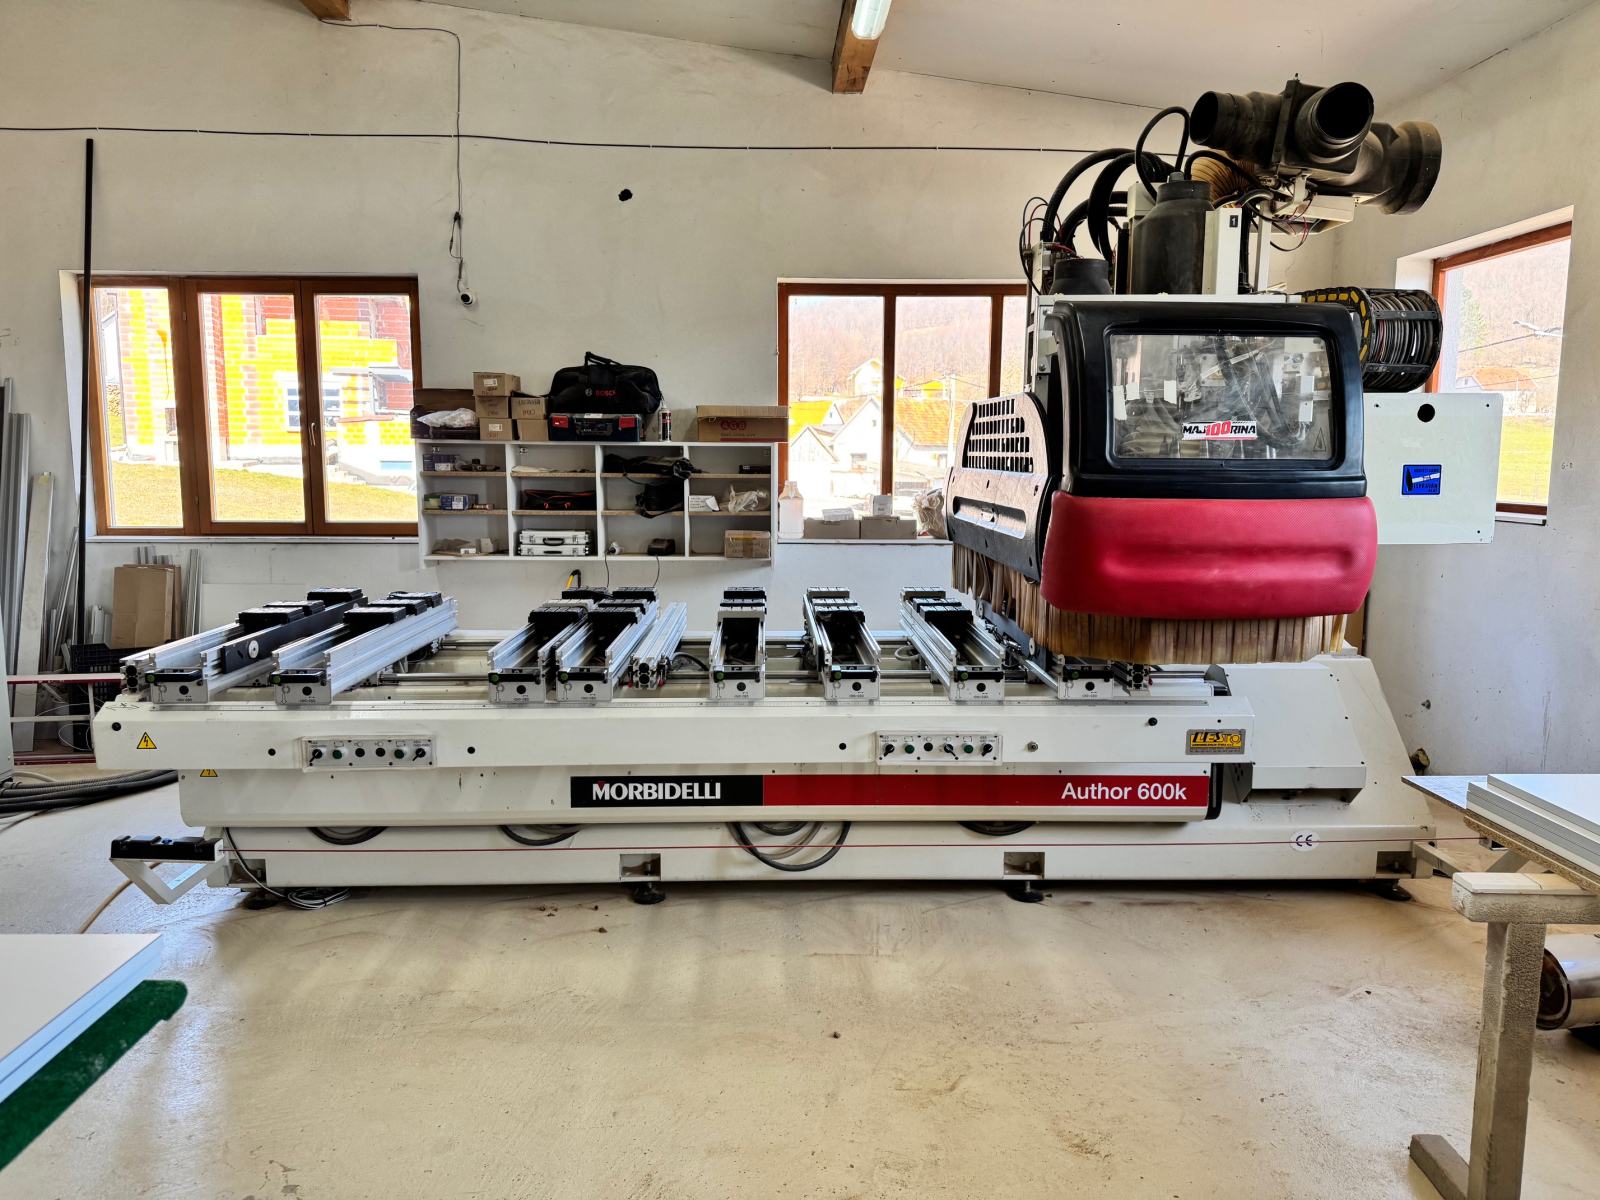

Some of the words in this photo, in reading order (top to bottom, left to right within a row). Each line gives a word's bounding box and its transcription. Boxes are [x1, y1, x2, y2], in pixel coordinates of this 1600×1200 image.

[592, 782, 721, 801] MORBIDELLI
[1061, 782, 1132, 800] Author
[1138, 782, 1187, 800] 600k
